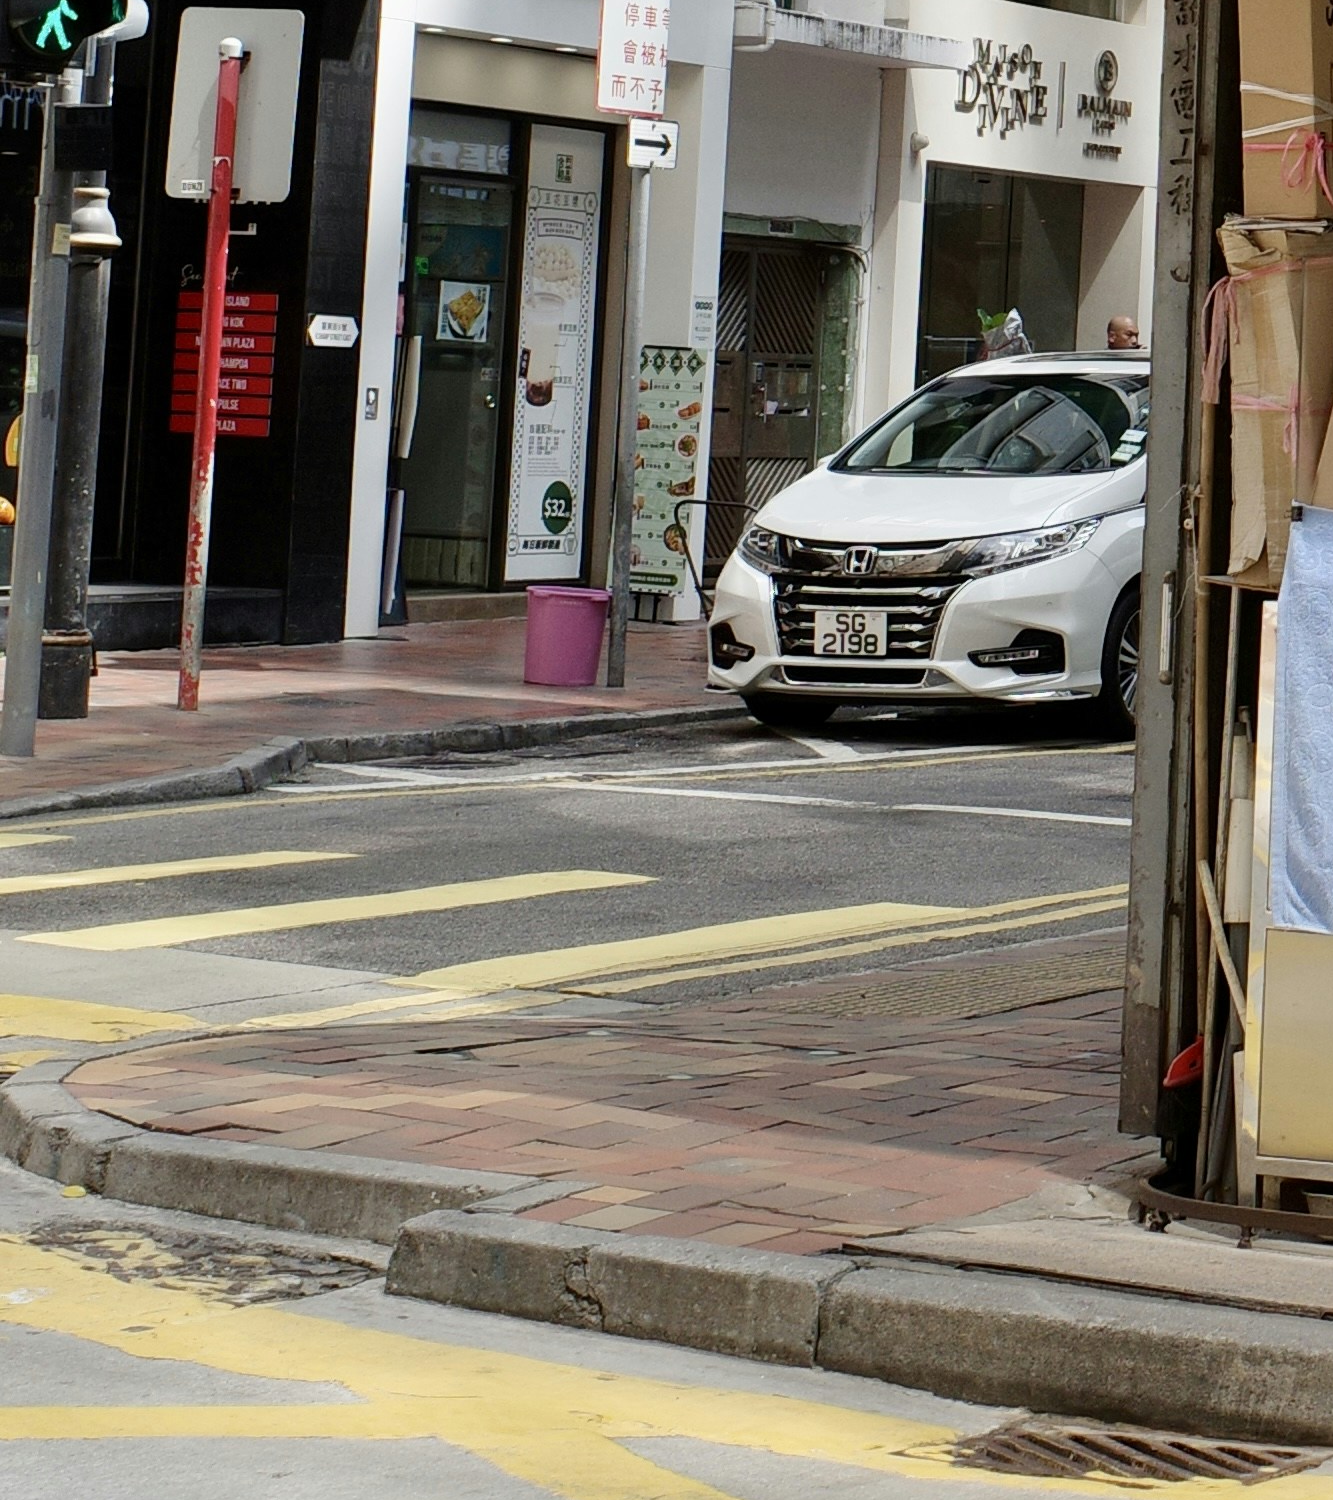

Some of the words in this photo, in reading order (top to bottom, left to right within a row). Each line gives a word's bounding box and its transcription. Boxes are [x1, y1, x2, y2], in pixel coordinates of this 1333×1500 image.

[611, 74, 663, 103] 而不予
[1078, 94, 1132, 117] BALMAIN
[835, 613, 866, 633] SG
[822, 633, 878, 655] 2198
